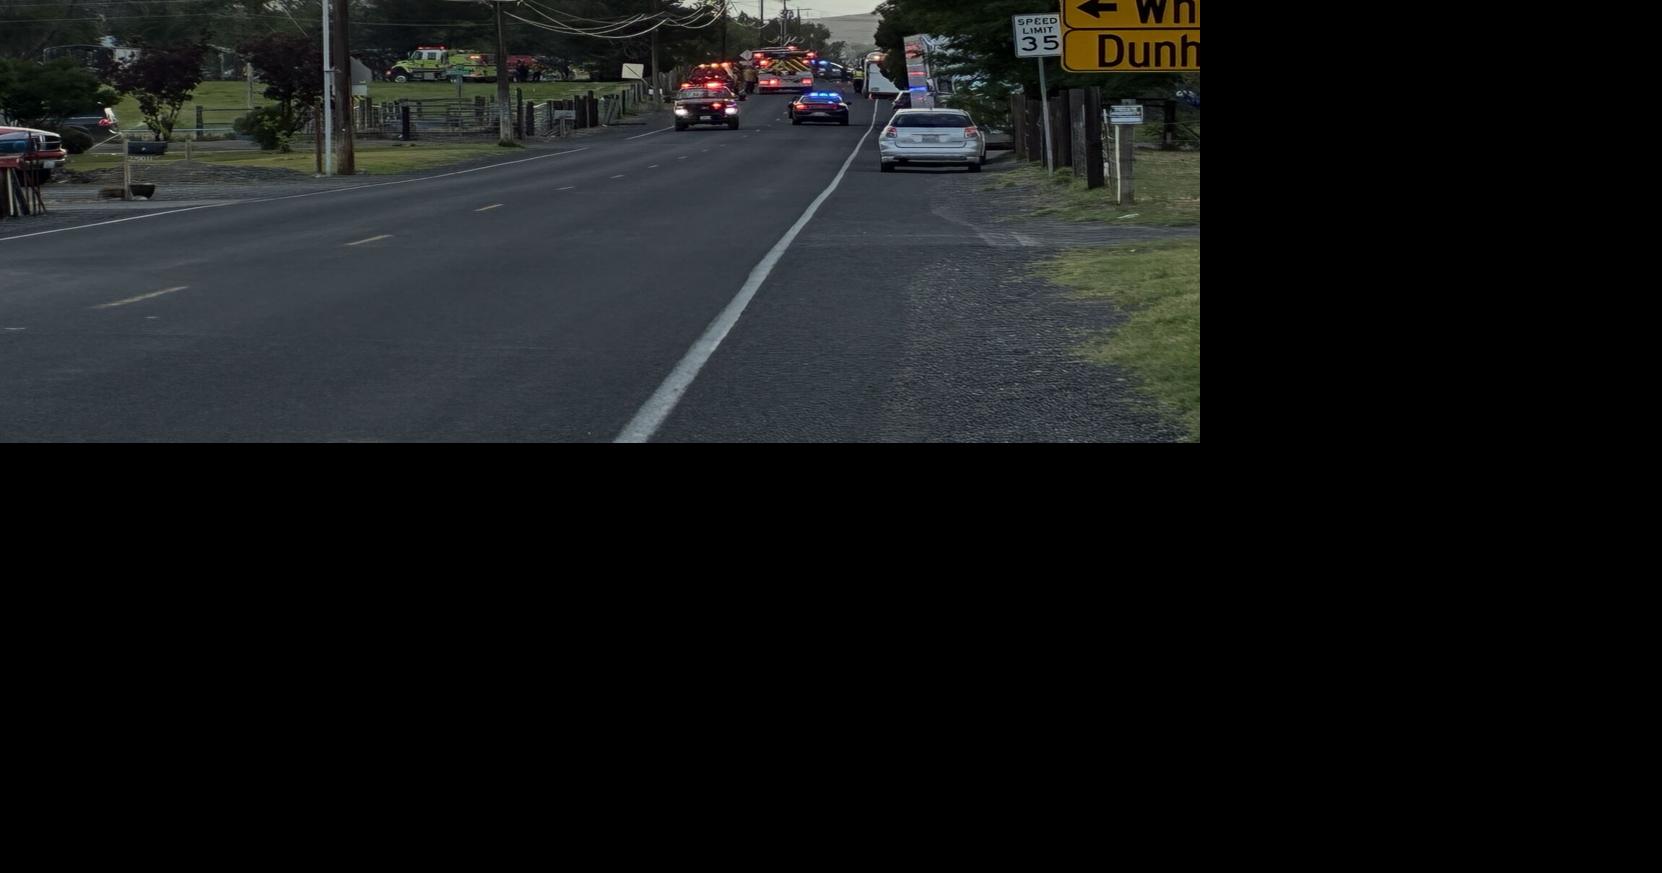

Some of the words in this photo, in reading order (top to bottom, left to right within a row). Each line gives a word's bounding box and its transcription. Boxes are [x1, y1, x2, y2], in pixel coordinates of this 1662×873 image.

[1017, 17, 1058, 26] SPEED
[1022, 26, 1053, 35] LIMIT
[1021, 35, 1060, 52] 35
[1098, 34, 1200, 68] Dunh
